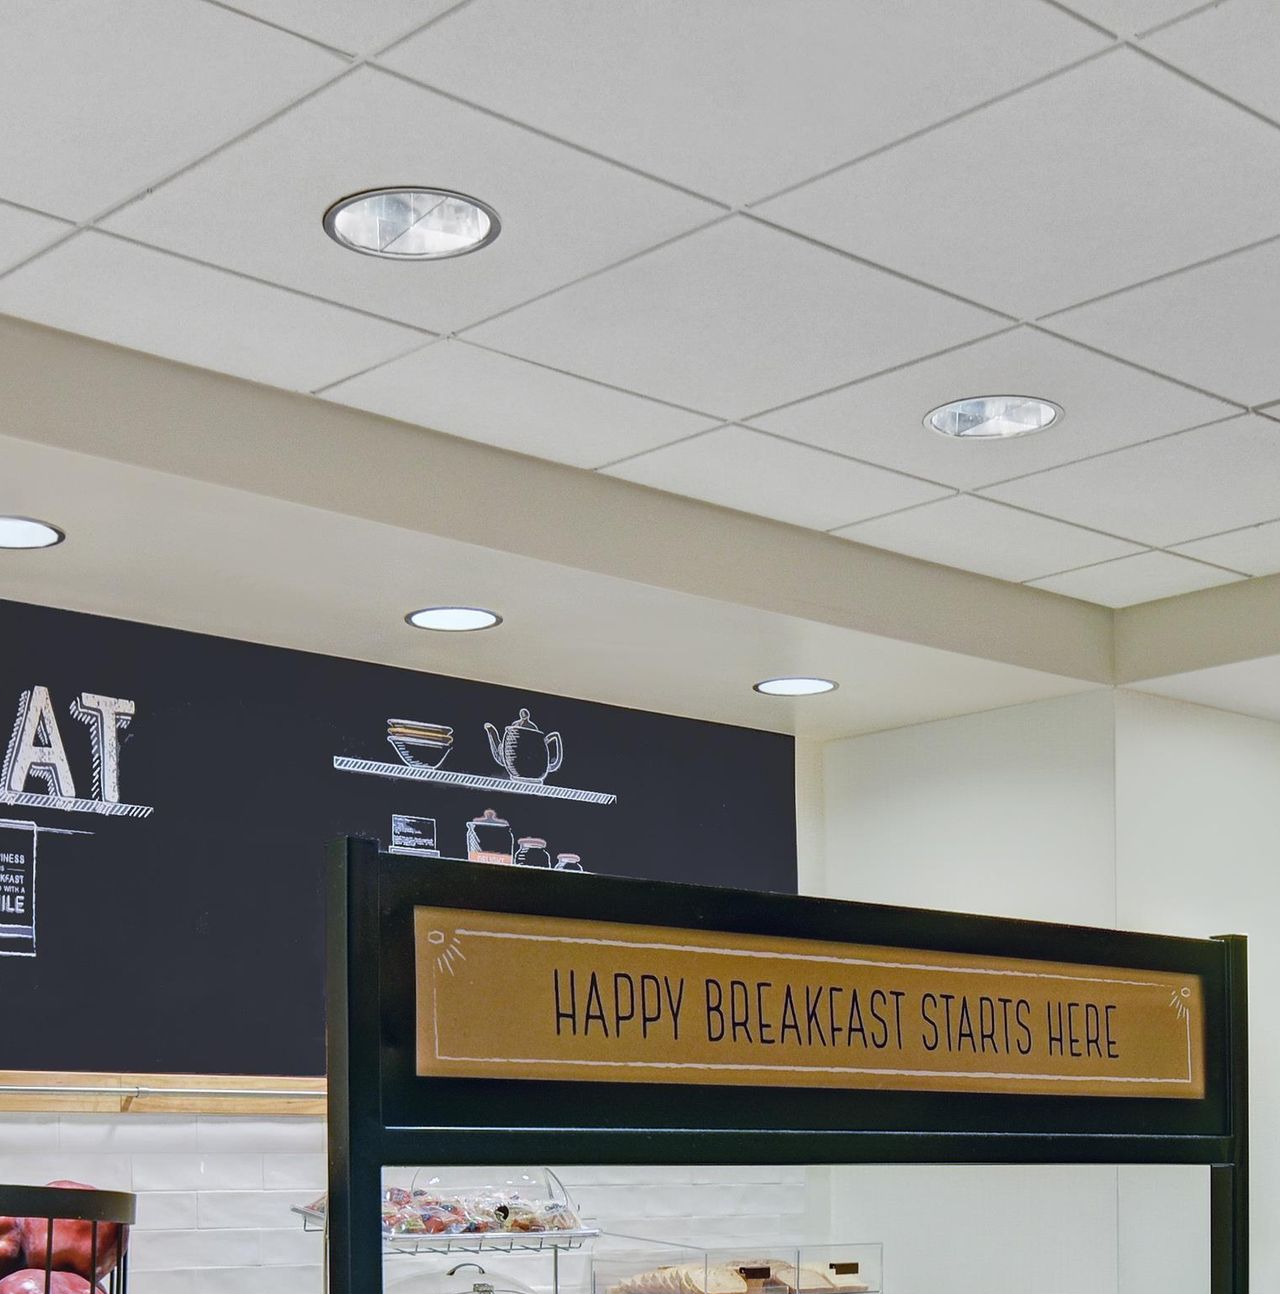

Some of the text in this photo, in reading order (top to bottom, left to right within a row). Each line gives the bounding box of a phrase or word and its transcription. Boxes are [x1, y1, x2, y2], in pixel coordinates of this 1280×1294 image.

[20, 886, 26, 894] A
[554, 969, 1119, 1058] HAPPY BREAKFAST STARTS HERE
